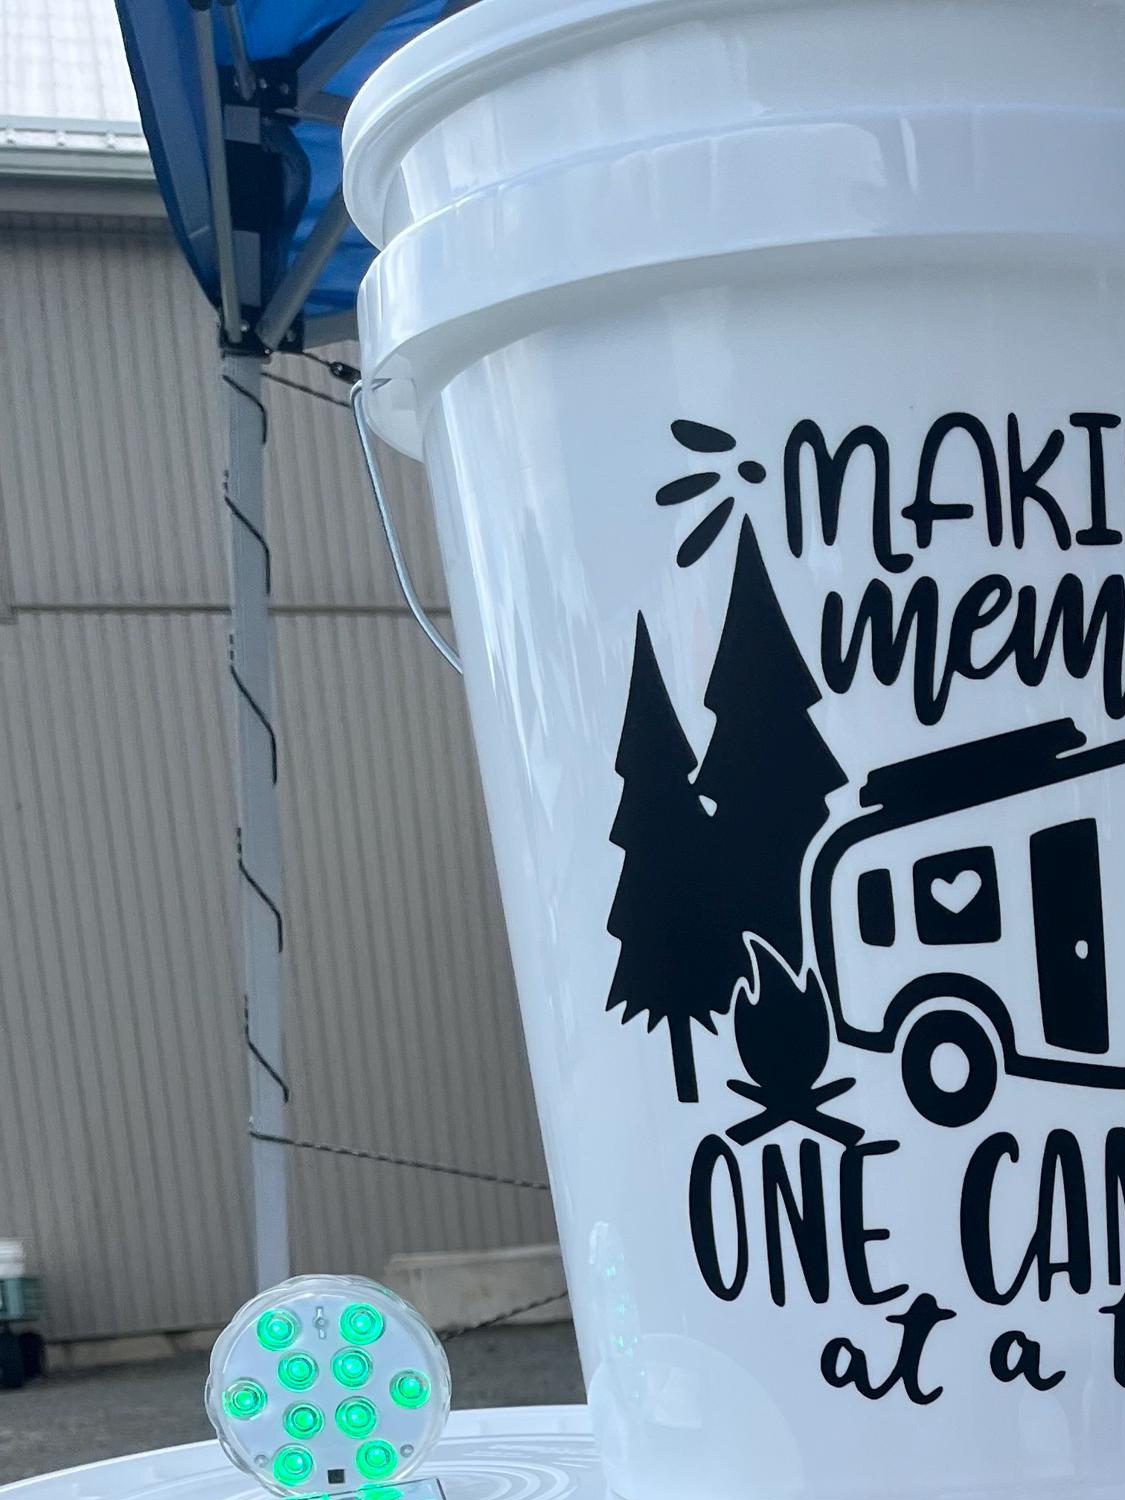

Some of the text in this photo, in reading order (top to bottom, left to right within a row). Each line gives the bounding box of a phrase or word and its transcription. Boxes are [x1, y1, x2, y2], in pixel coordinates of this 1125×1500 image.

[688, 1133, 909, 1307] ONE
[820, 1292, 957, 1405] at
[990, 1330, 1066, 1391] a
